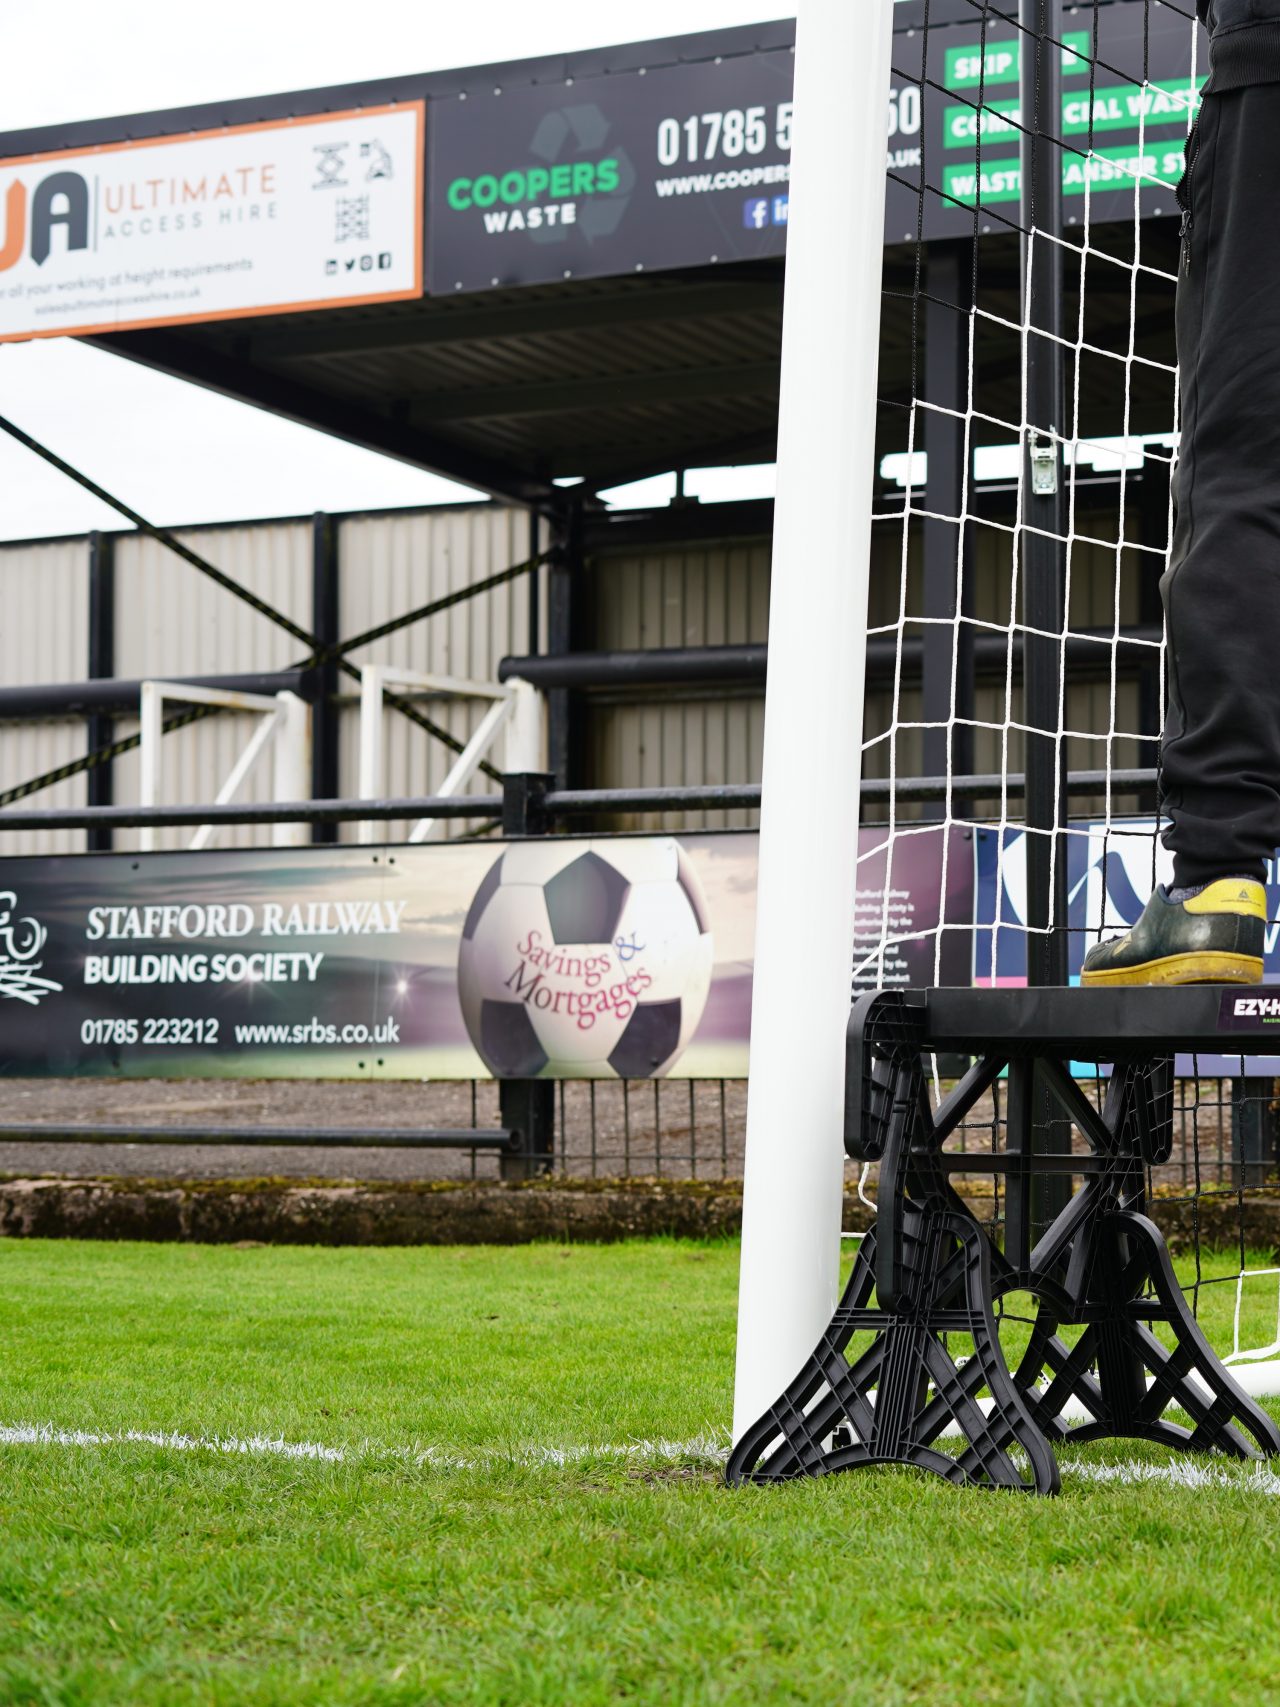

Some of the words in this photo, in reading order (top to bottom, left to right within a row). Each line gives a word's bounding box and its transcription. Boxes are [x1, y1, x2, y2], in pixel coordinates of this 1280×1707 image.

[954, 53, 1012, 79] SKIP
[657, 106, 767, 166] 01785
[104, 164, 277, 214] ULTIMATE
[447, 158, 620, 211] COOPERS
[950, 173, 1021, 197] WAST
[104, 209, 203, 239] ACCESS
[219, 202, 278, 225] HIRE
[484, 202, 577, 233] WASTE
[9, 284, 24, 298] all
[27, 284, 53, 301] your
[57, 275, 106, 293] working
[125, 268, 165, 287] height
[169, 259, 253, 281] requirements
[85, 904, 253, 940] STAFFORD
[260, 901, 408, 937] RAILWAY
[84, 955, 208, 984] BUILDING
[210, 952, 324, 983] SOCIETY
[516, 930, 612, 988] Savings
[615, 932, 646, 961] &
[504, 960, 652, 1030] Mortgages
[80, 1018, 138, 1044] 01785
[142, 1017, 219, 1044] 223212
[234, 1016, 400, 1044] www.srbs.co.uk
